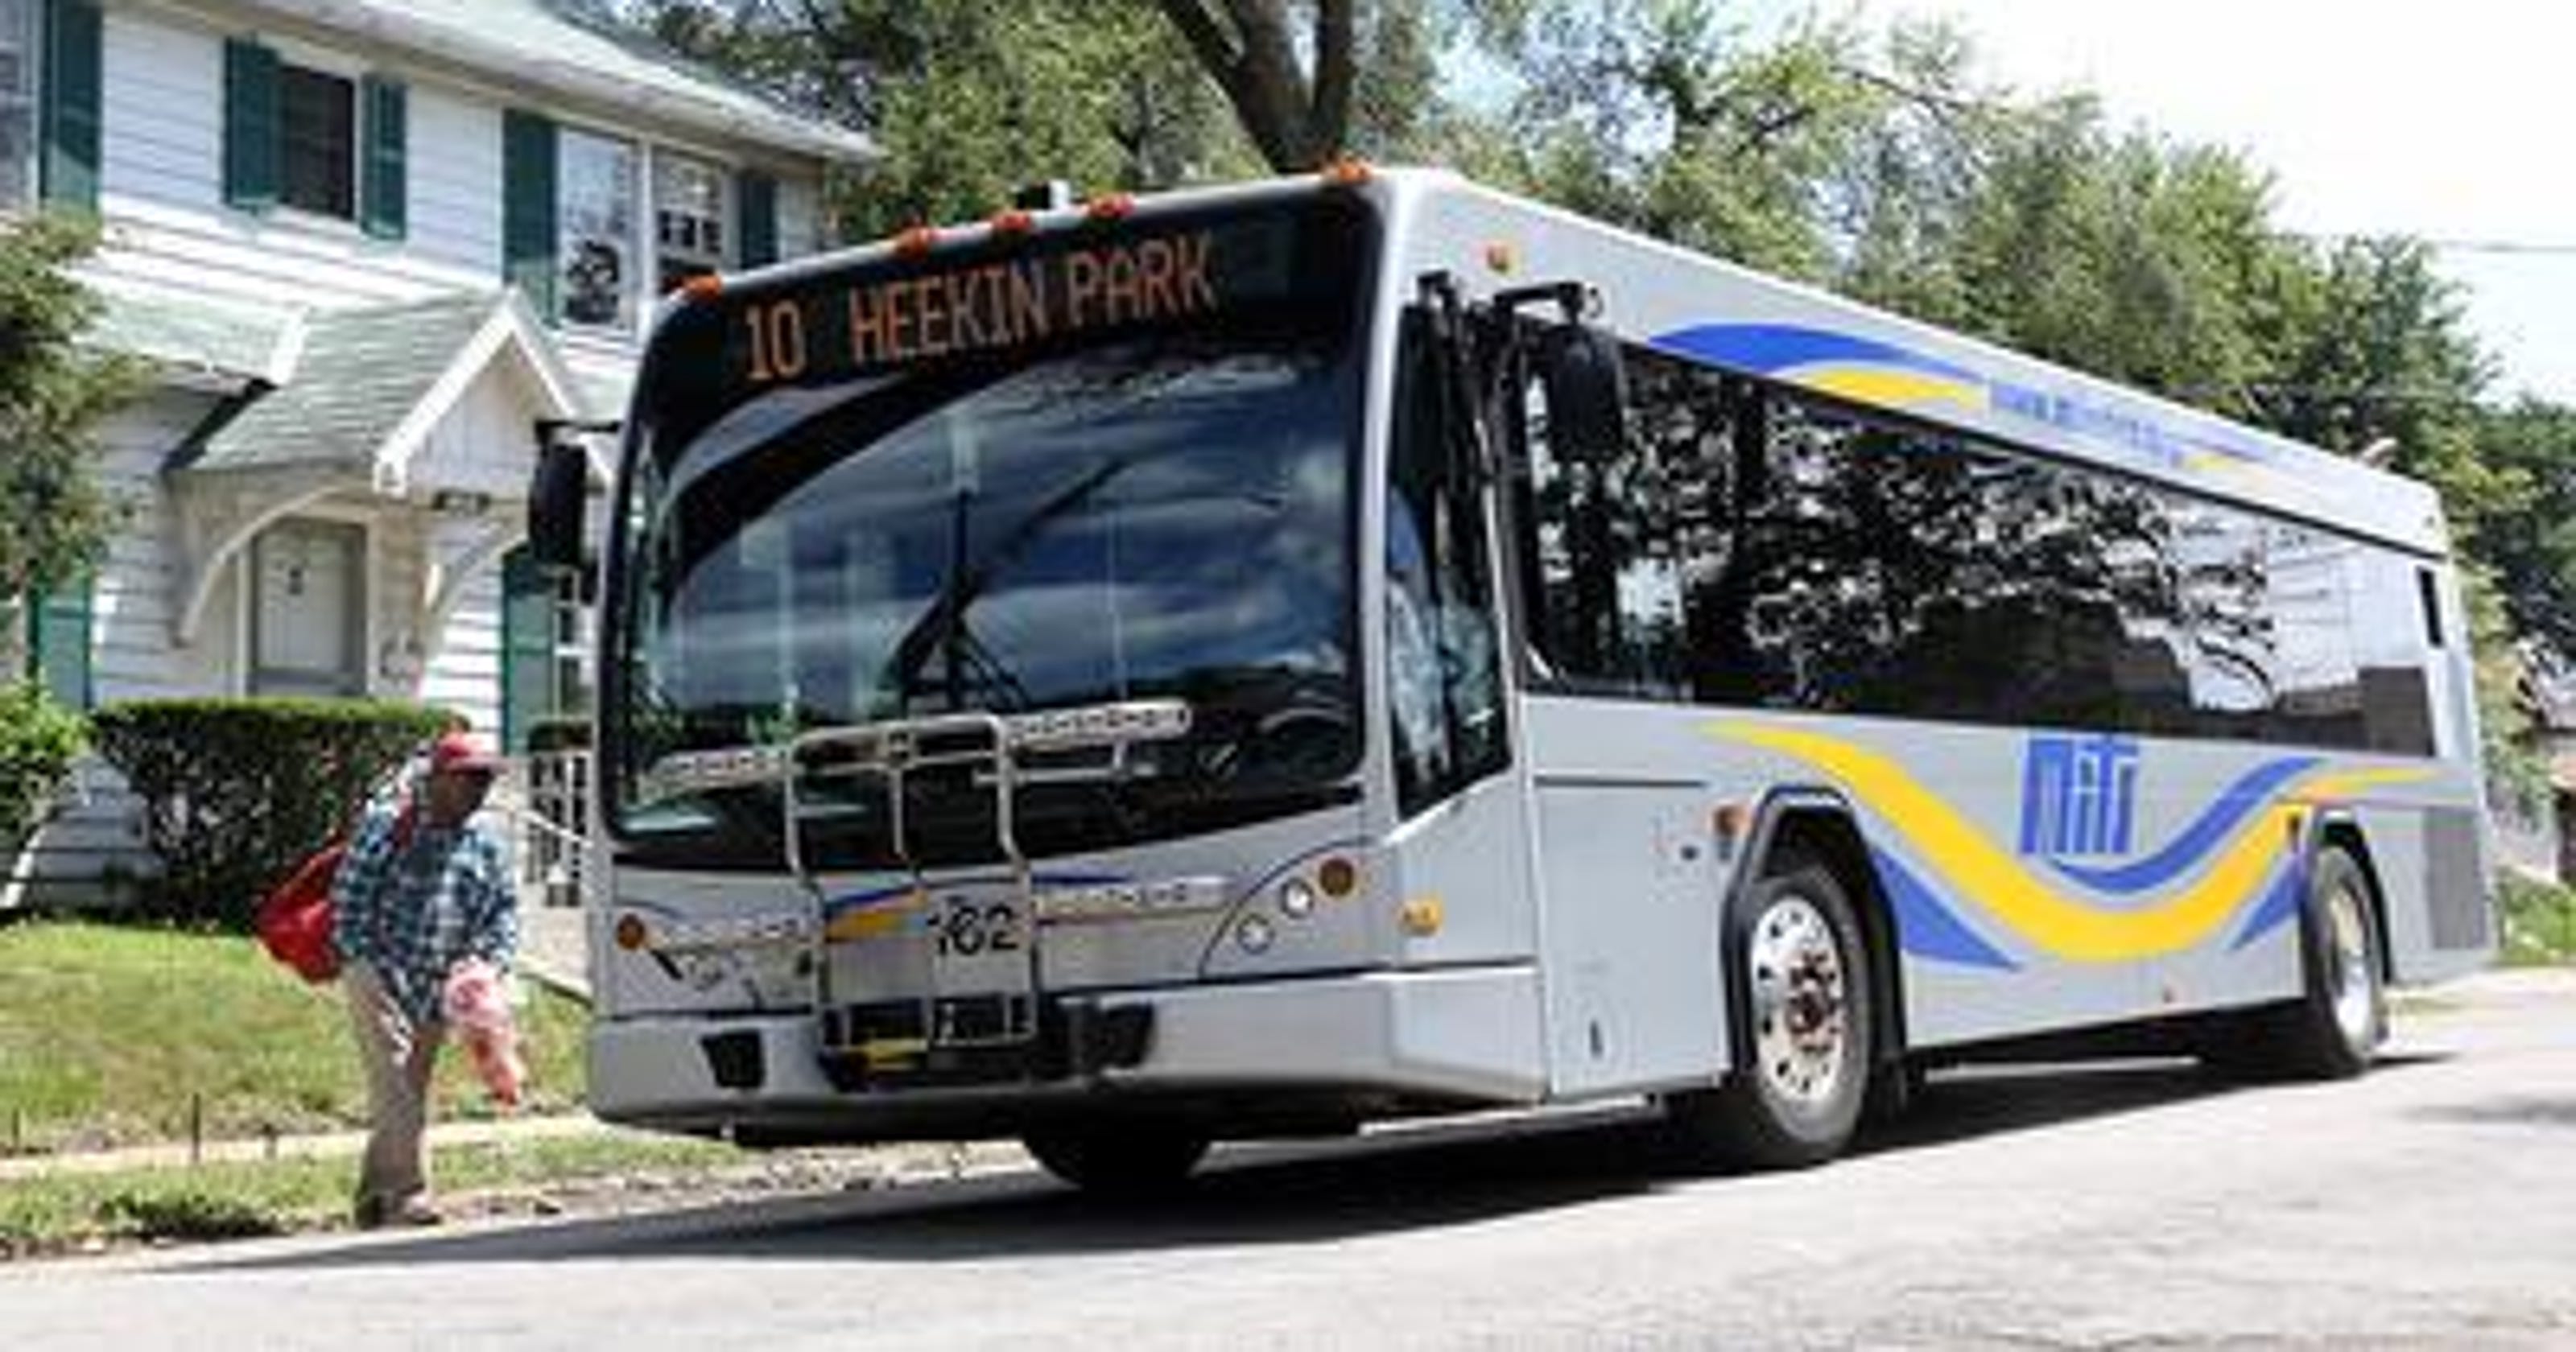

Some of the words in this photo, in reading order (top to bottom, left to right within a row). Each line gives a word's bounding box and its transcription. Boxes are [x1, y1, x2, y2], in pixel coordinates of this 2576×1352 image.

[745, 299, 805, 380] 10
[848, 262, 1047, 363] HEEKIN
[1067, 237, 1217, 325] PARK
